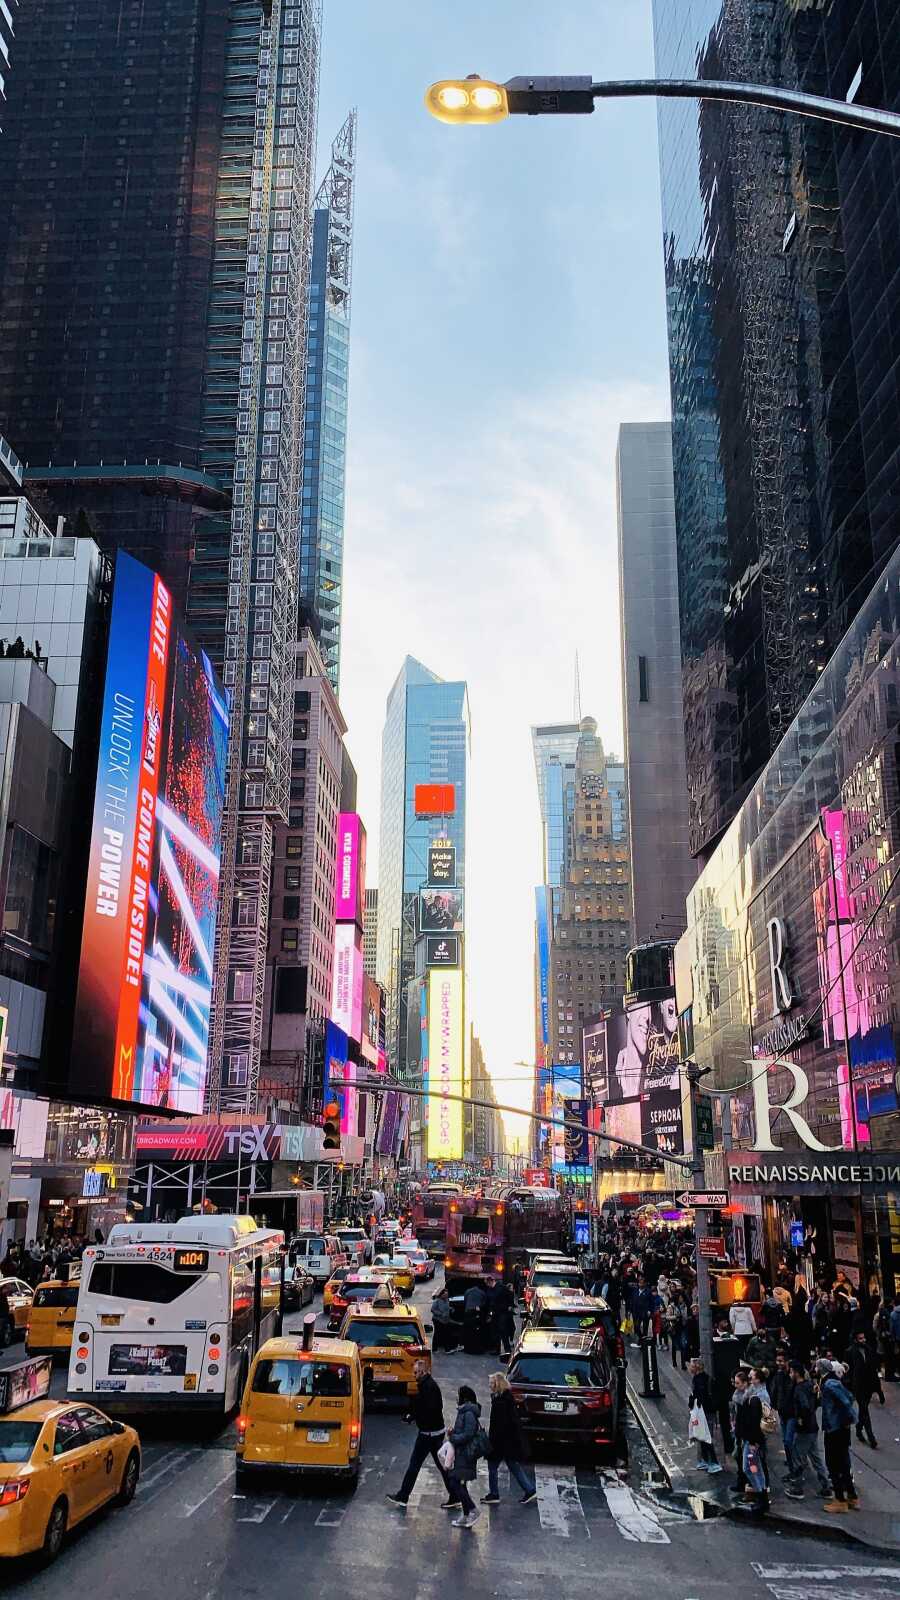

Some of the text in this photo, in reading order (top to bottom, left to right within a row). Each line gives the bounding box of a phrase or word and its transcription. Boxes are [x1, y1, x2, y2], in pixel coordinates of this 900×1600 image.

[95, 692, 135, 918] UNLOCK THE POWER
[136, 787, 154, 869] COME
[431, 853, 452, 861] Make
[433, 861, 450, 870] your
[126, 872, 148, 987] INSIDE!
[766, 916, 792, 1020] R
[650, 1107, 682, 1123] SEPHORA
[742, 1059, 845, 1152] R
[223, 1124, 271, 1161] TSX
[284, 1127, 304, 1161] TSX
[728, 1165, 862, 1182] RENAISSANCE
[681, 1195, 699, 1204] ONE
[706, 1195, 725, 1204] WAY
[147, 1251, 172, 1262] 4524
